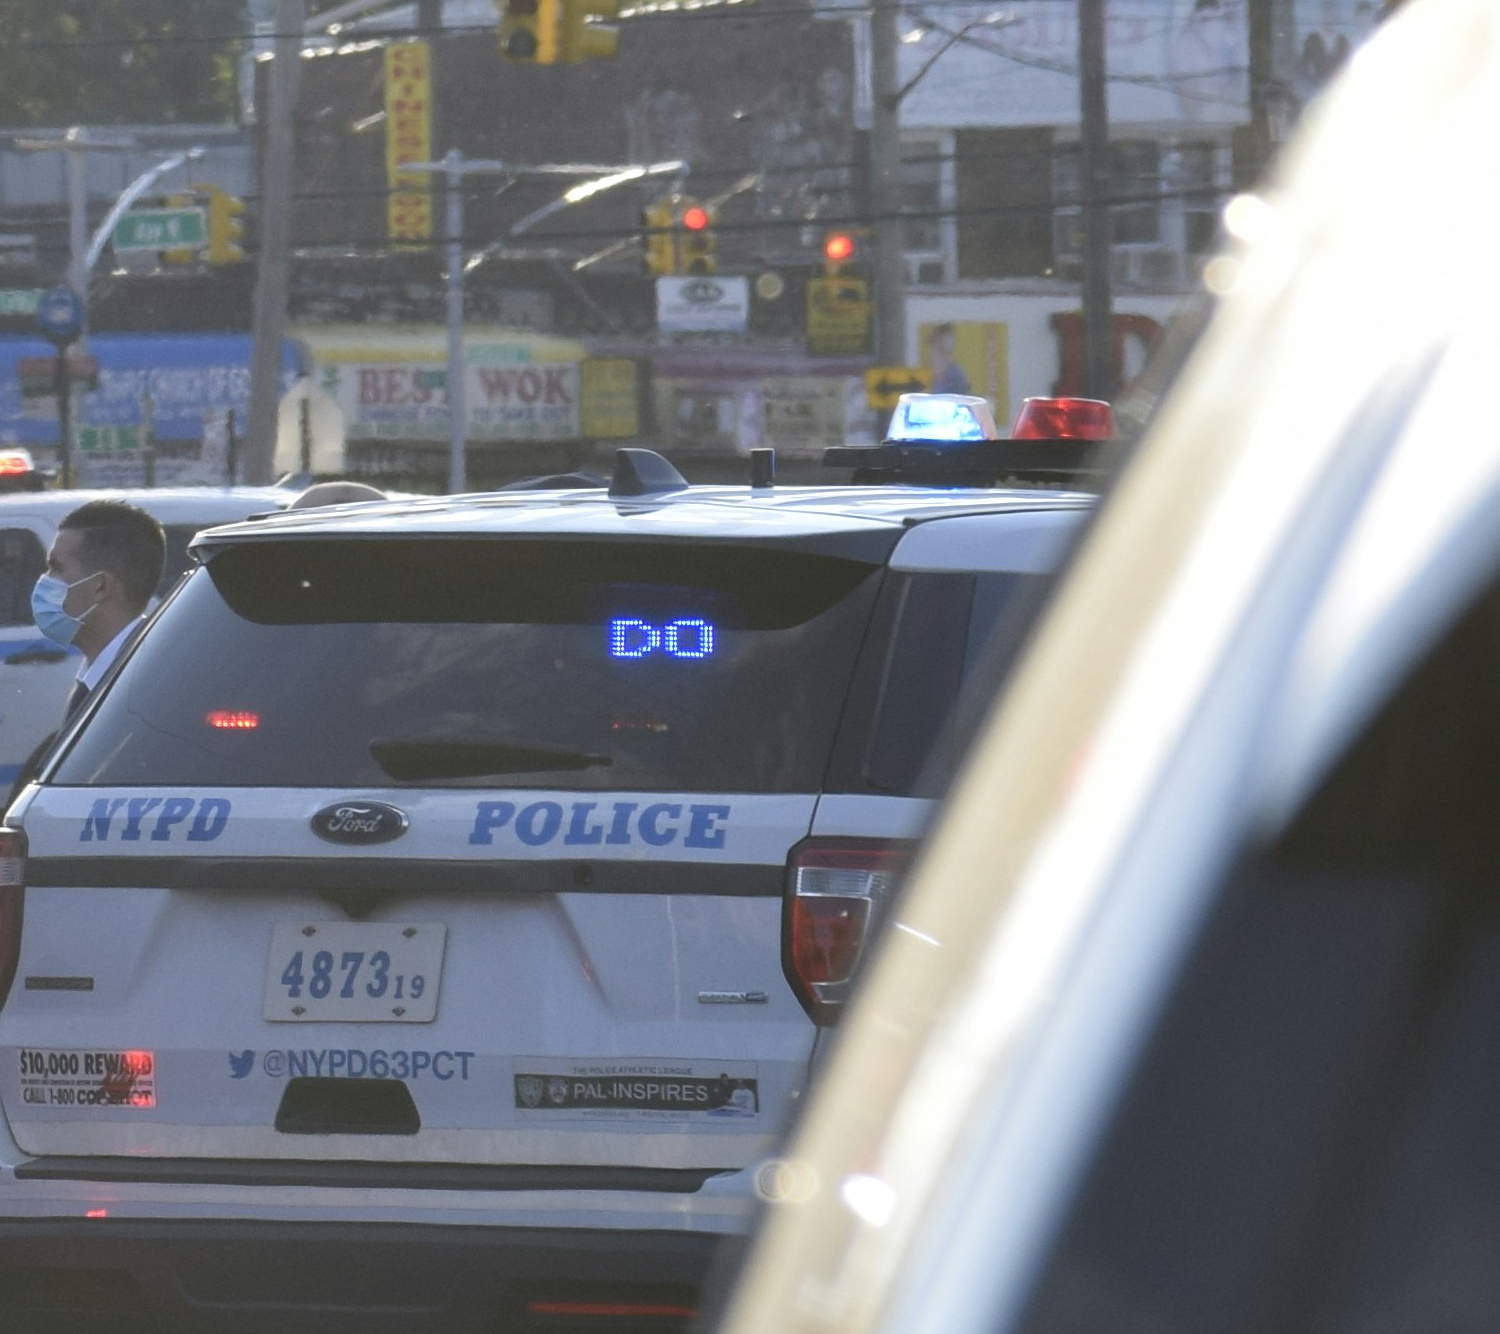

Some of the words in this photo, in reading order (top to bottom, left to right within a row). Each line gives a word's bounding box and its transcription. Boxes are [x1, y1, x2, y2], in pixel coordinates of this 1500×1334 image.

[356, 368, 451, 405] BES
[478, 367, 574, 405] WOK
[612, 619, 713, 658] DO
[80, 797, 232, 842] NYPD
[327, 806, 382, 834] Ford
[469, 801, 731, 850] POLICE
[281, 950, 391, 1000] 4873
[393, 974, 426, 1000] 19
[20, 1049, 79, 1078] $10,000
[84, 1052, 153, 1076] REWARD
[262, 1049, 476, 1080] @NYPD63PCT
[23, 1087, 47, 1105] CALL
[49, 1088, 75, 1105] 1-800
